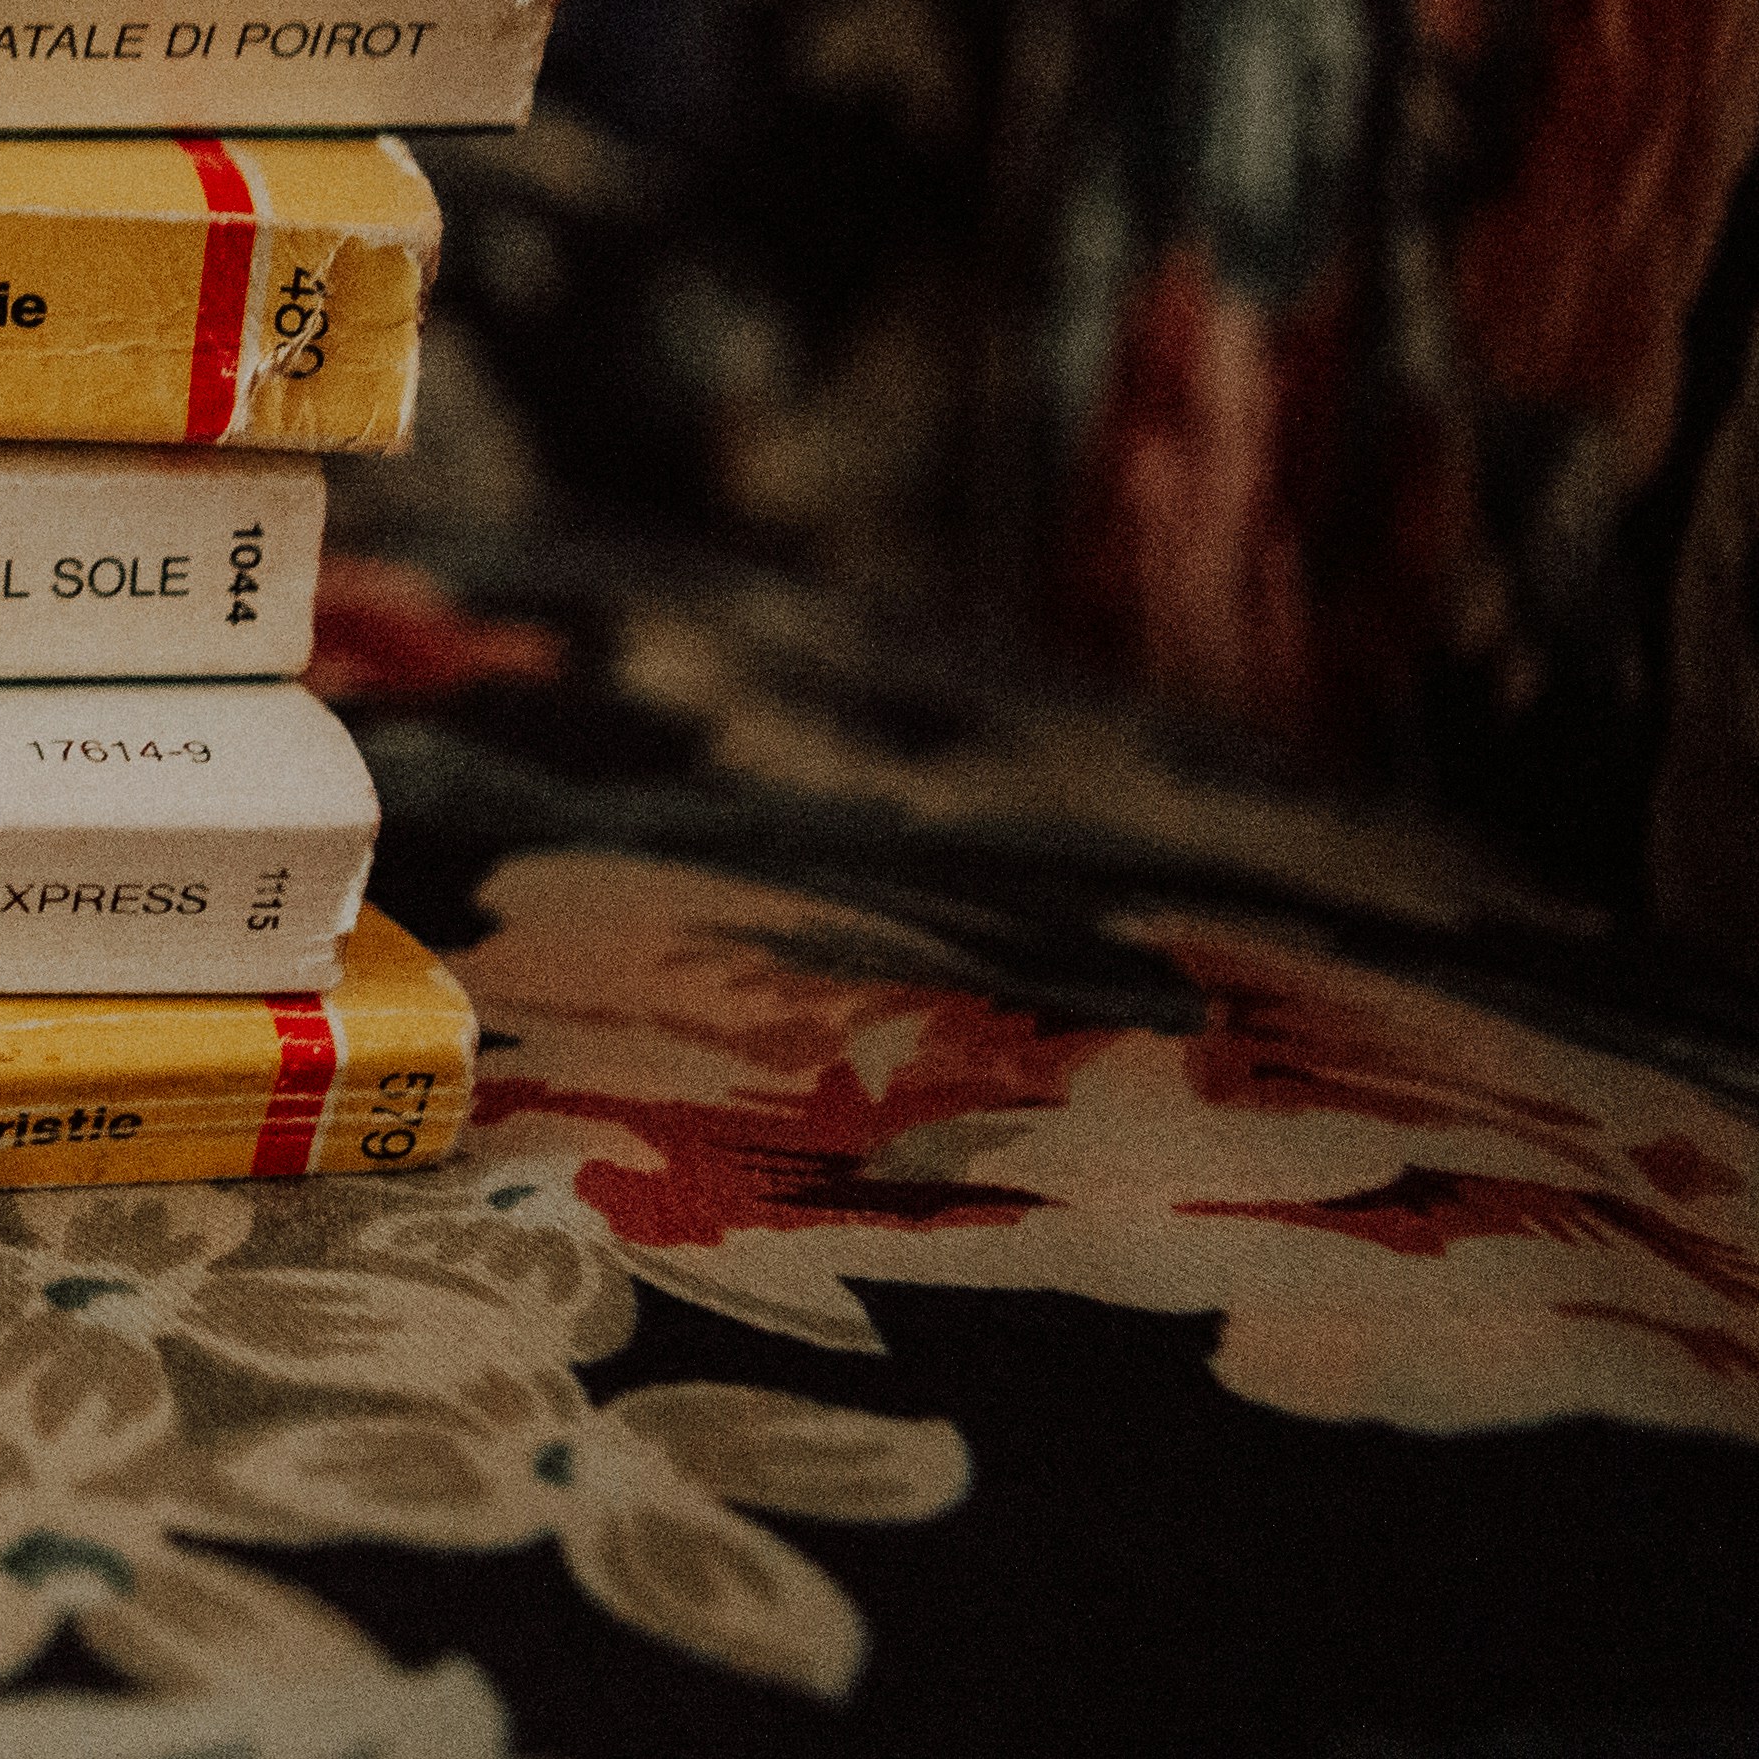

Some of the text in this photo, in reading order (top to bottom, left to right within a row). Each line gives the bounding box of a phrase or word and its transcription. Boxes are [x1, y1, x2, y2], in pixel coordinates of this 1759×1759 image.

[164, 21, 217, 59] DI
[234, 19, 438, 59] POIROT
[51, 555, 192, 600] SOLE
[225, 521, 264, 627] 1044
[26, 739, 213, 764] 17614-9
[246, 867, 291, 933] 1115
[360, 1072, 437, 1162] 579
